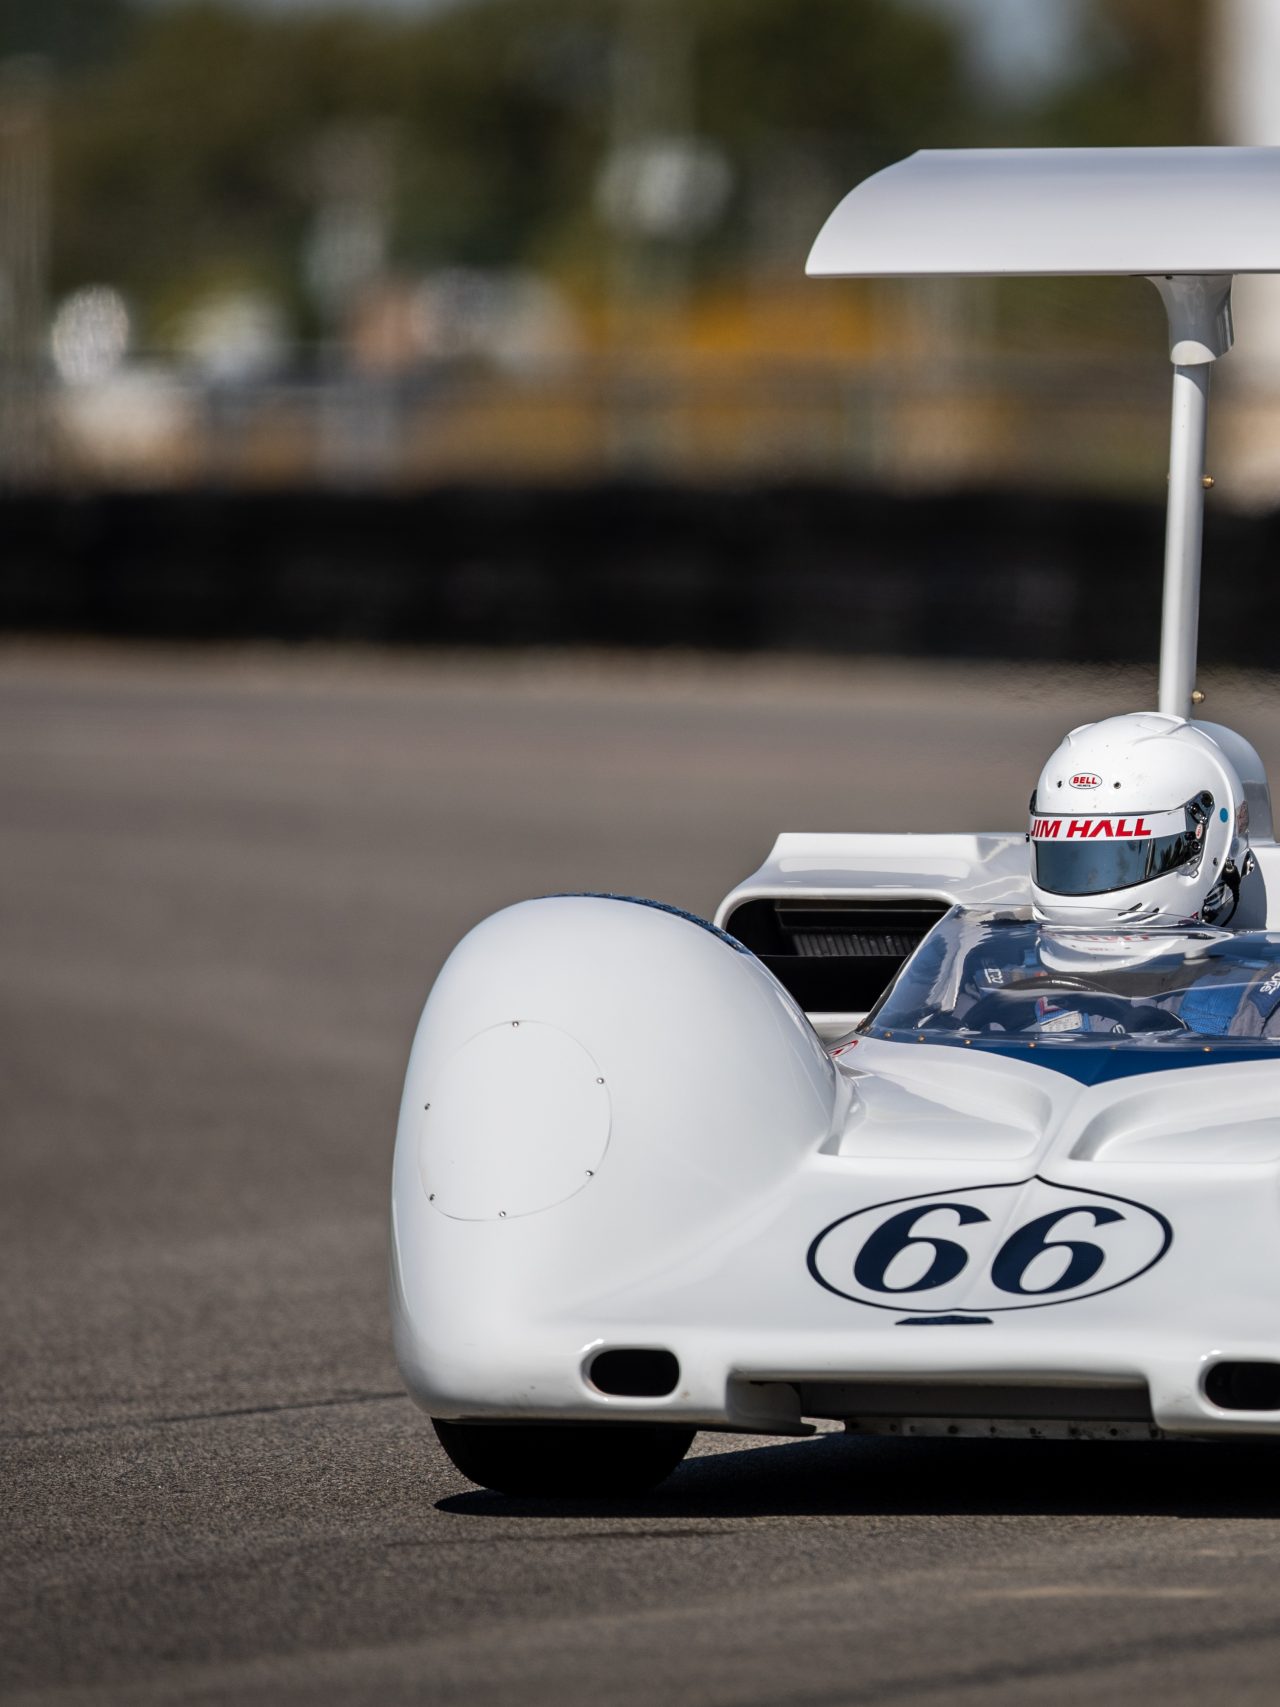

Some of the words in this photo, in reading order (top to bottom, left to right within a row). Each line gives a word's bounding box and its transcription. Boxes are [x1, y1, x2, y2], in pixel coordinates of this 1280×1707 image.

[1073, 776, 1097, 784] BELL
[1031, 819, 1062, 838] JIM
[1066, 818, 1152, 838] HALL
[853, 1202, 1126, 1296] 66
